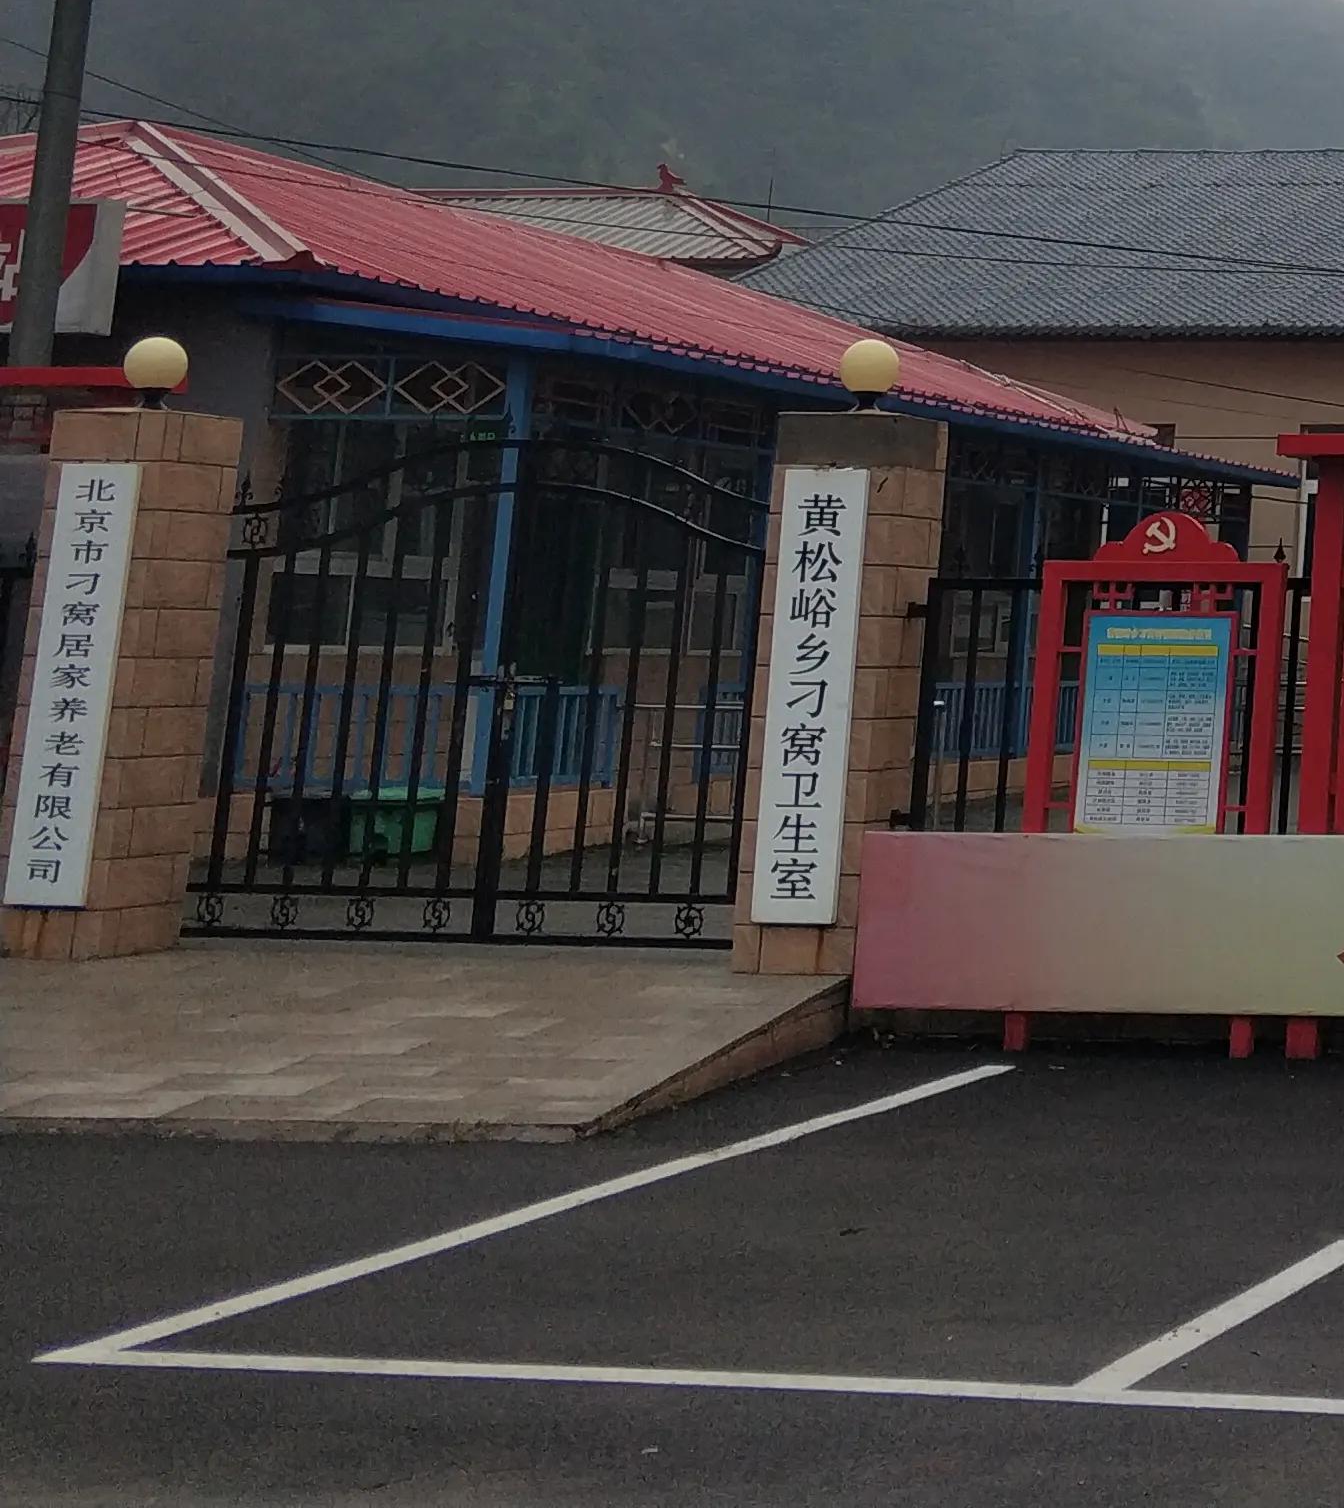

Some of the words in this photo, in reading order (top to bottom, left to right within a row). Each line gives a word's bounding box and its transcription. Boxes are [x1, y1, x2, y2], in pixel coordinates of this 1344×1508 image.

[27, 479, 116, 884] 北京市刁窝居家养老有限公司
[769, 493, 847, 900] 黄松峪乡刁窝卫生室
